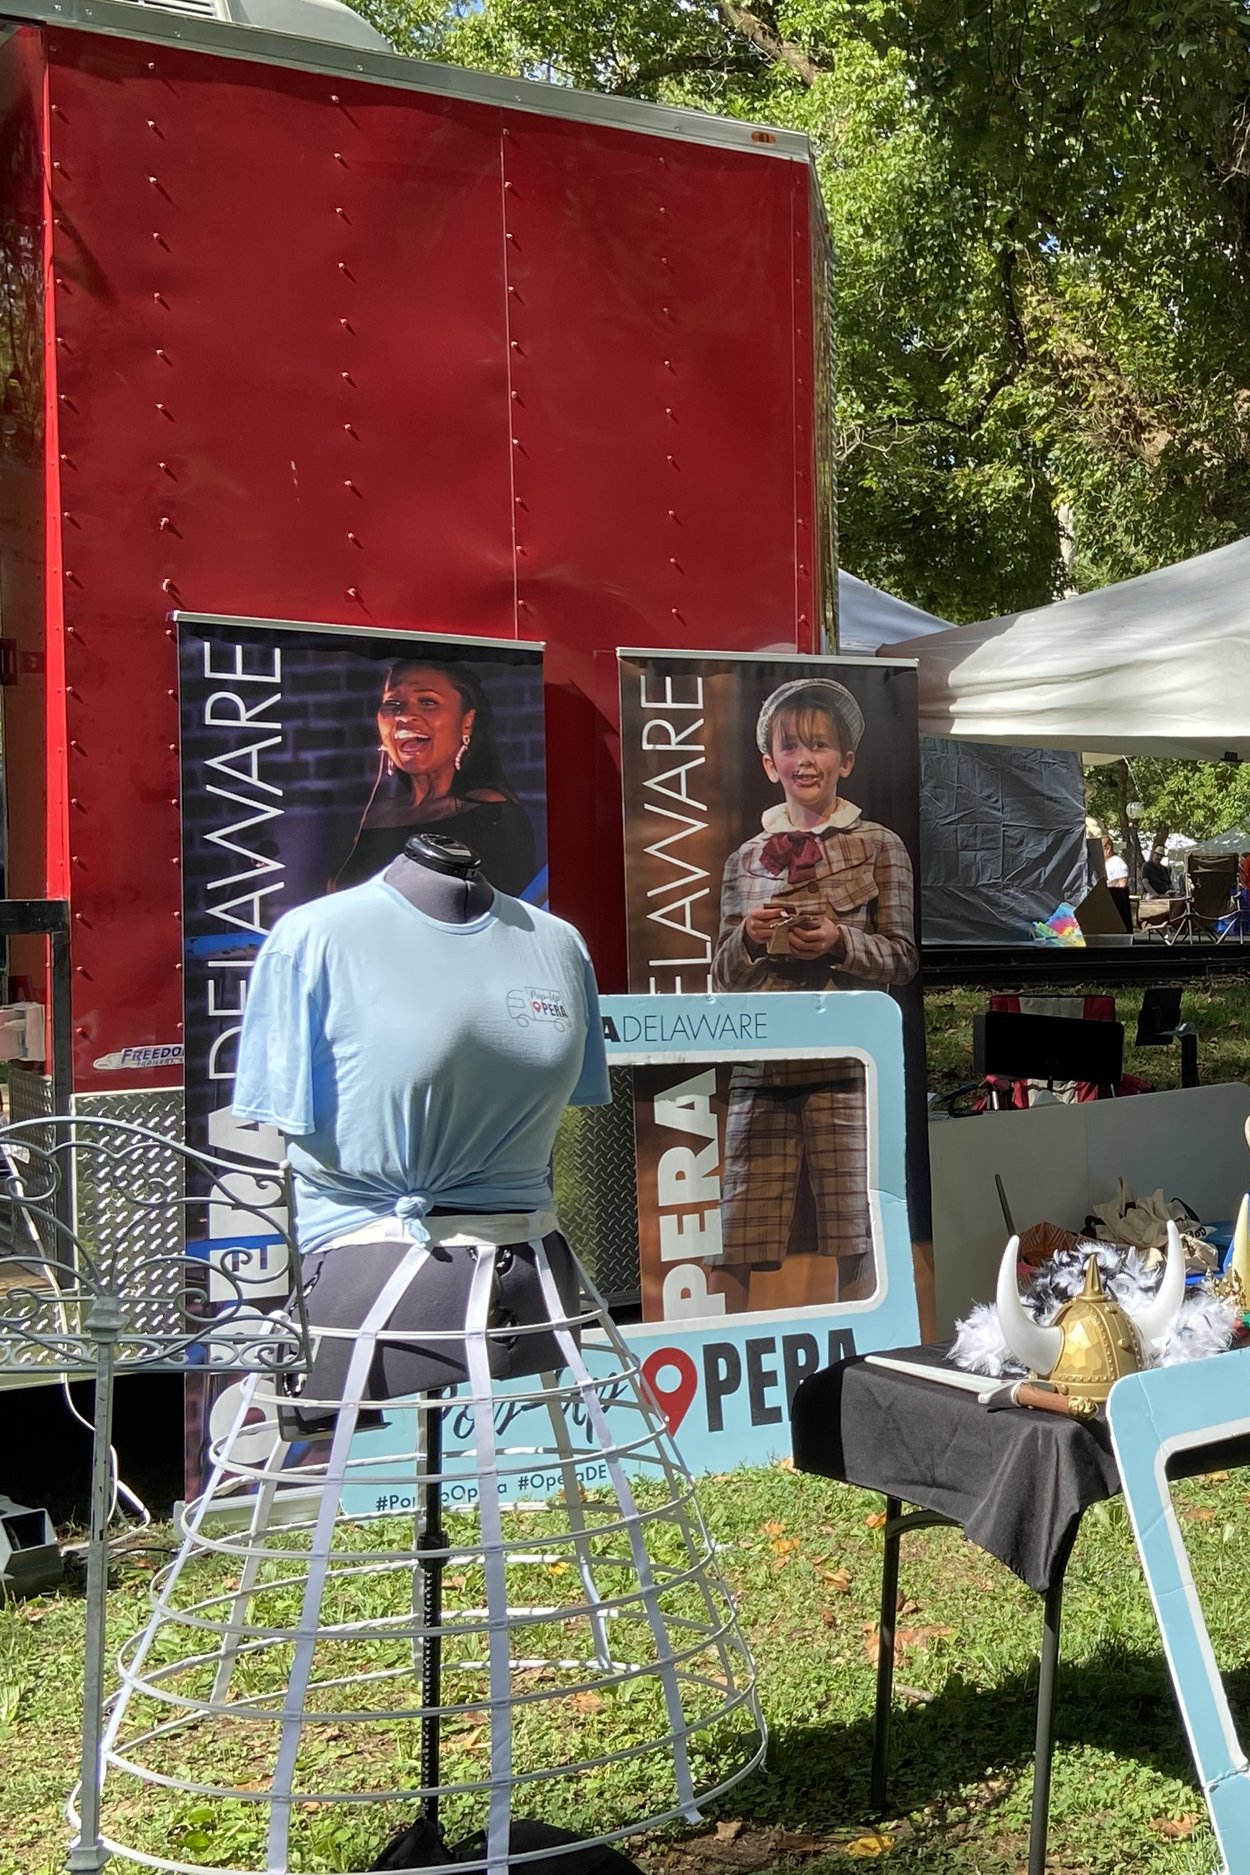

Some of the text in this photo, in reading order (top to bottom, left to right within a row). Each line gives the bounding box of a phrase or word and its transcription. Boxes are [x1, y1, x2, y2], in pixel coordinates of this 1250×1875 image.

[600, 1013, 768, 1043] ADELAWARE
[121, 1046, 184, 1064] FREEDO
[518, 1464, 607, 1491] #OpeaDE
